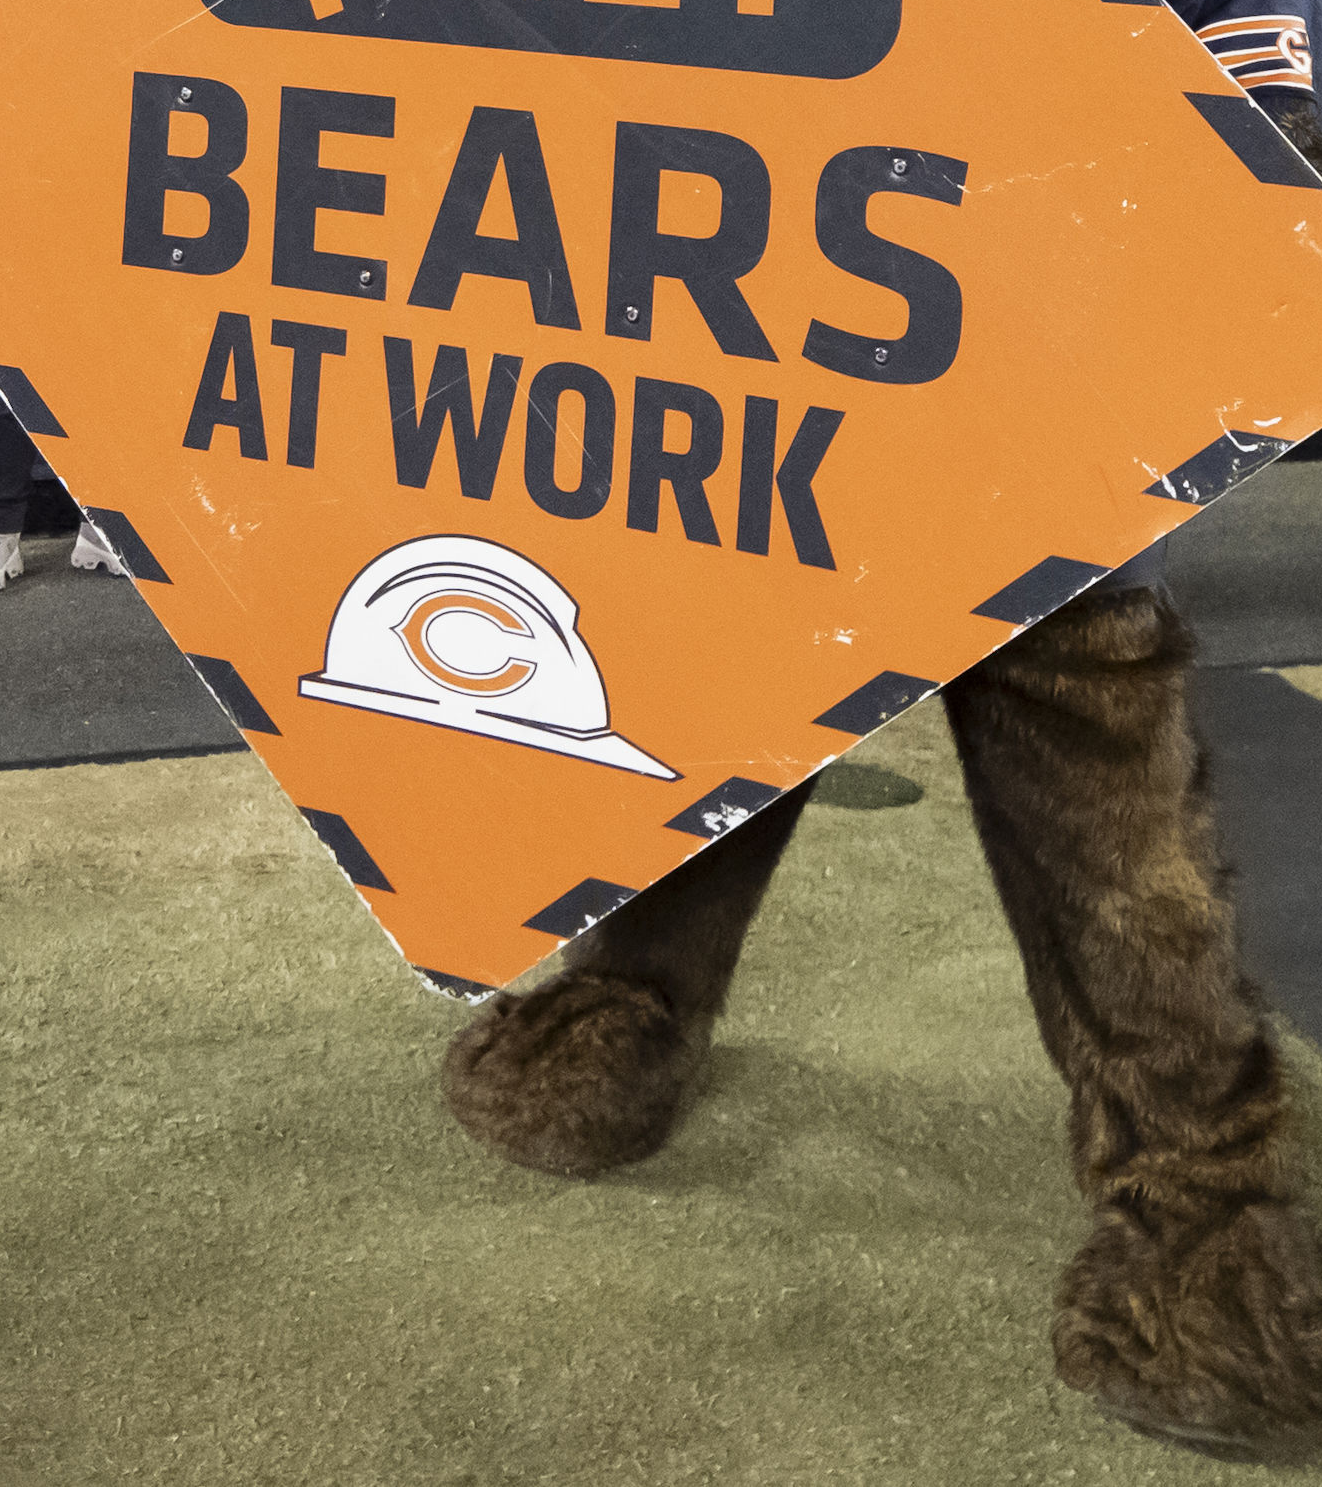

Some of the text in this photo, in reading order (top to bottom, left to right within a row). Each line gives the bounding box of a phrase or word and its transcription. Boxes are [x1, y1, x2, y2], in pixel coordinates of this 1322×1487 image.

[121, 69, 970, 387] BEARS
[180, 311, 847, 575] AT WORK
